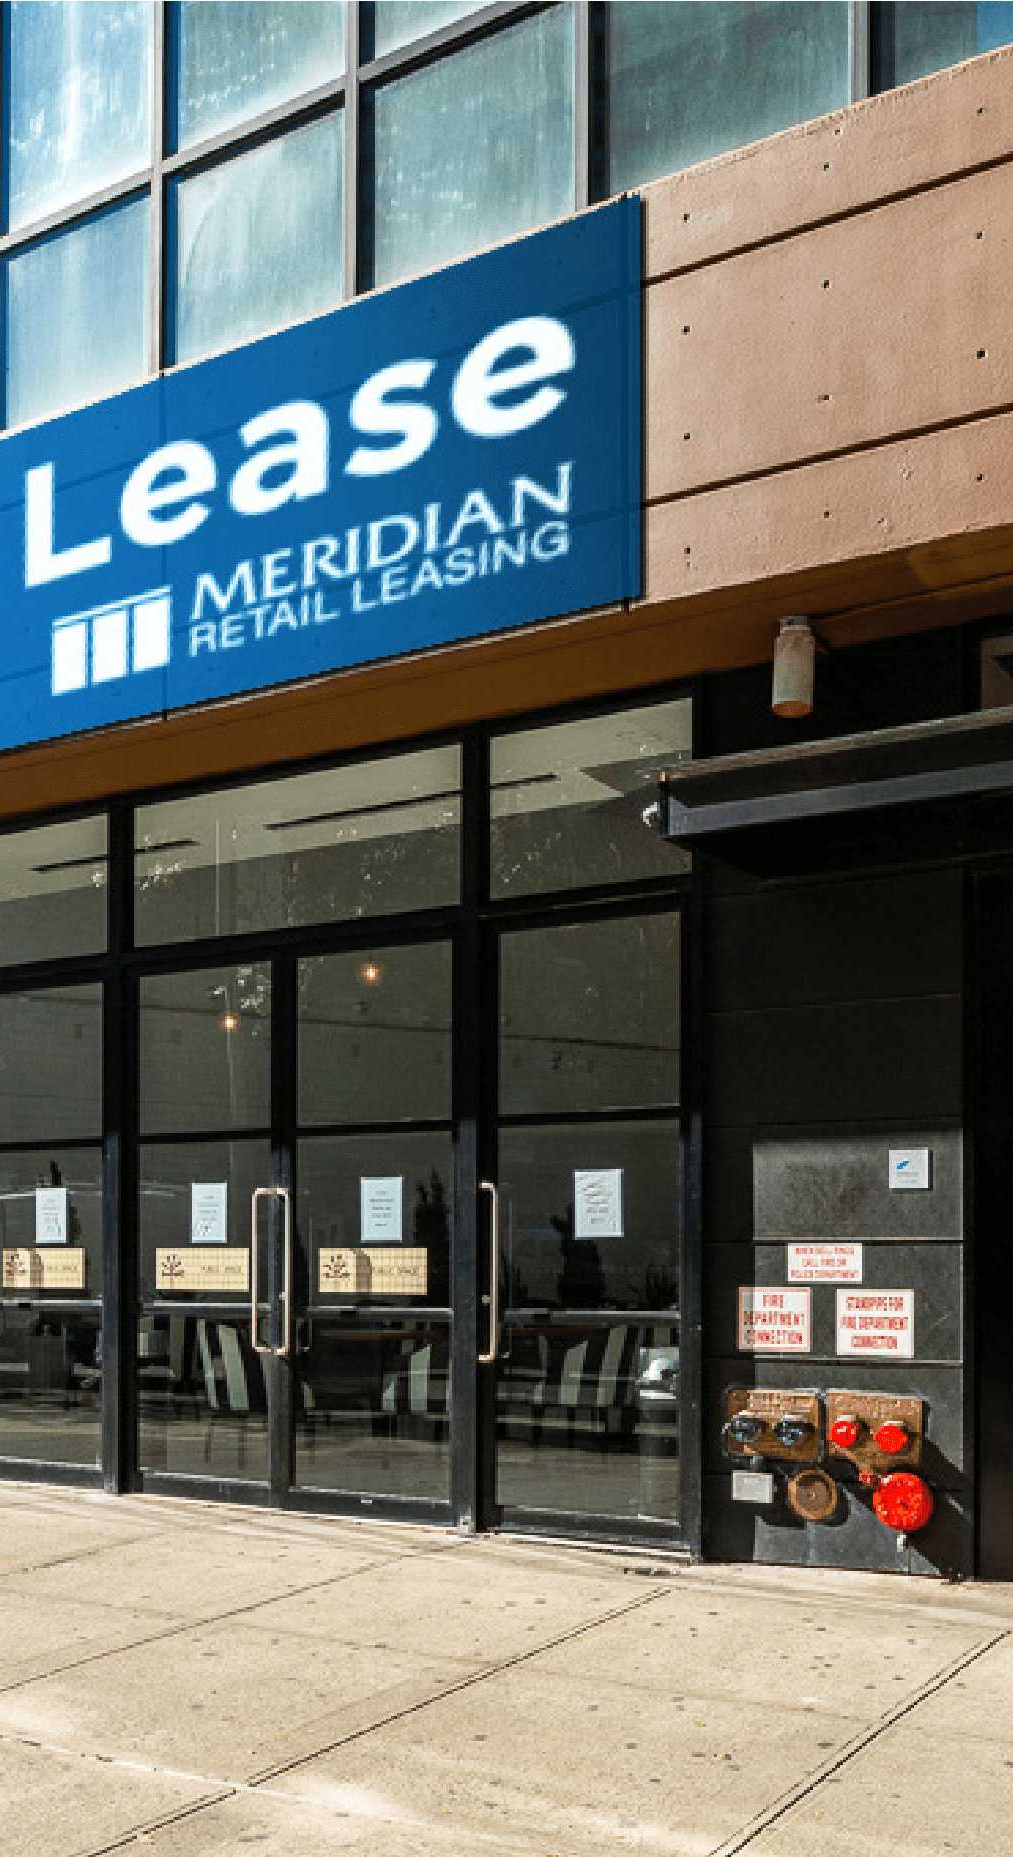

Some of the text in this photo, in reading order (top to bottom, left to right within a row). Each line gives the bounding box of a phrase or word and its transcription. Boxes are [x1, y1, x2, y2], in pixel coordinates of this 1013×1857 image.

[24, 315, 576, 588] Lease
[190, 461, 572, 621] MERIDIAN
[190, 519, 570, 657] RETAIL LEASING
